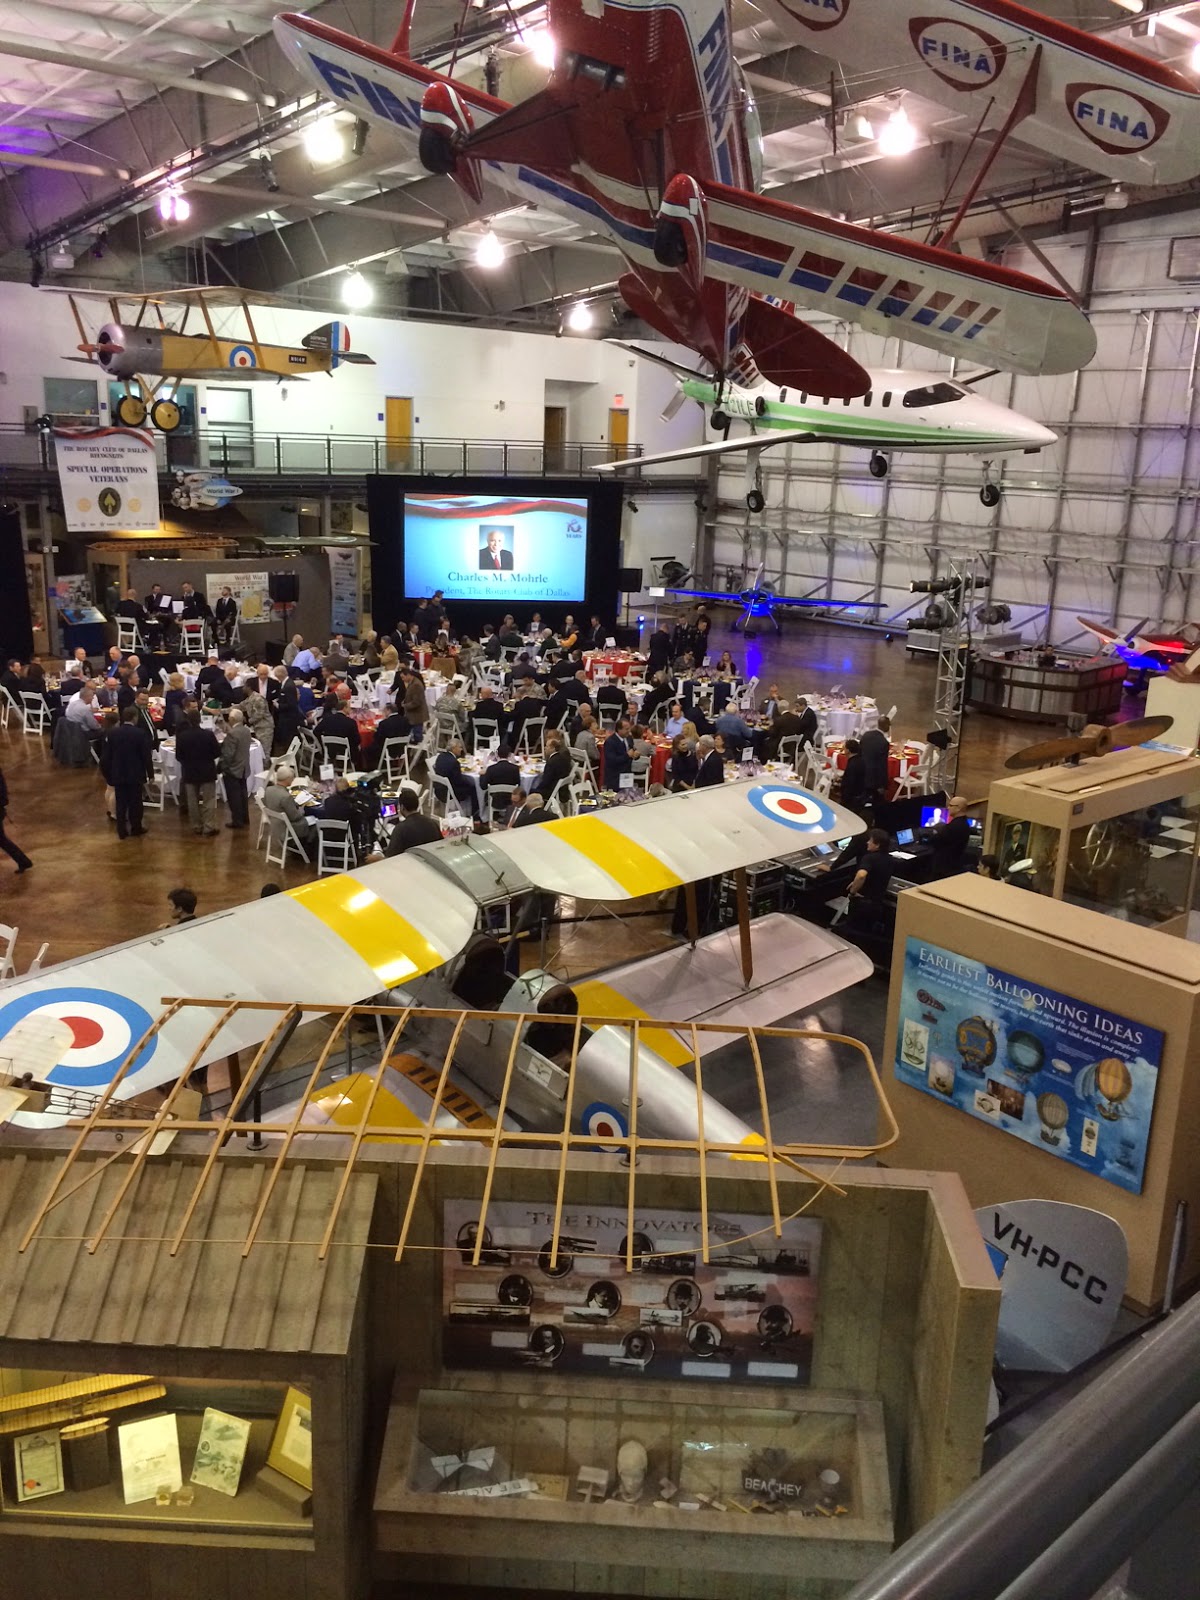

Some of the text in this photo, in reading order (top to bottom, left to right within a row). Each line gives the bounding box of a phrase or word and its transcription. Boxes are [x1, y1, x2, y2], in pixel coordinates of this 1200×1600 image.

[922, 37, 991, 75] FINA
[308, 51, 422, 130] FIN
[1077, 101, 1149, 140] FINA
[101, 466, 148, 474] OPERATIONS
[447, 572, 549, 584] Charles M. Mohrle
[513, 587, 533, 596] Club
[534, 588, 544, 596] of
[546, 588, 571, 597] Dallas
[919, 947, 1143, 1045] EARLIEST BALLOONING IDEAS
[586, 1215, 741, 1235] INNOVATORS
[995, 1212, 1107, 1304] VH-PCC
[744, 1477, 802, 1497] BEACHEY
